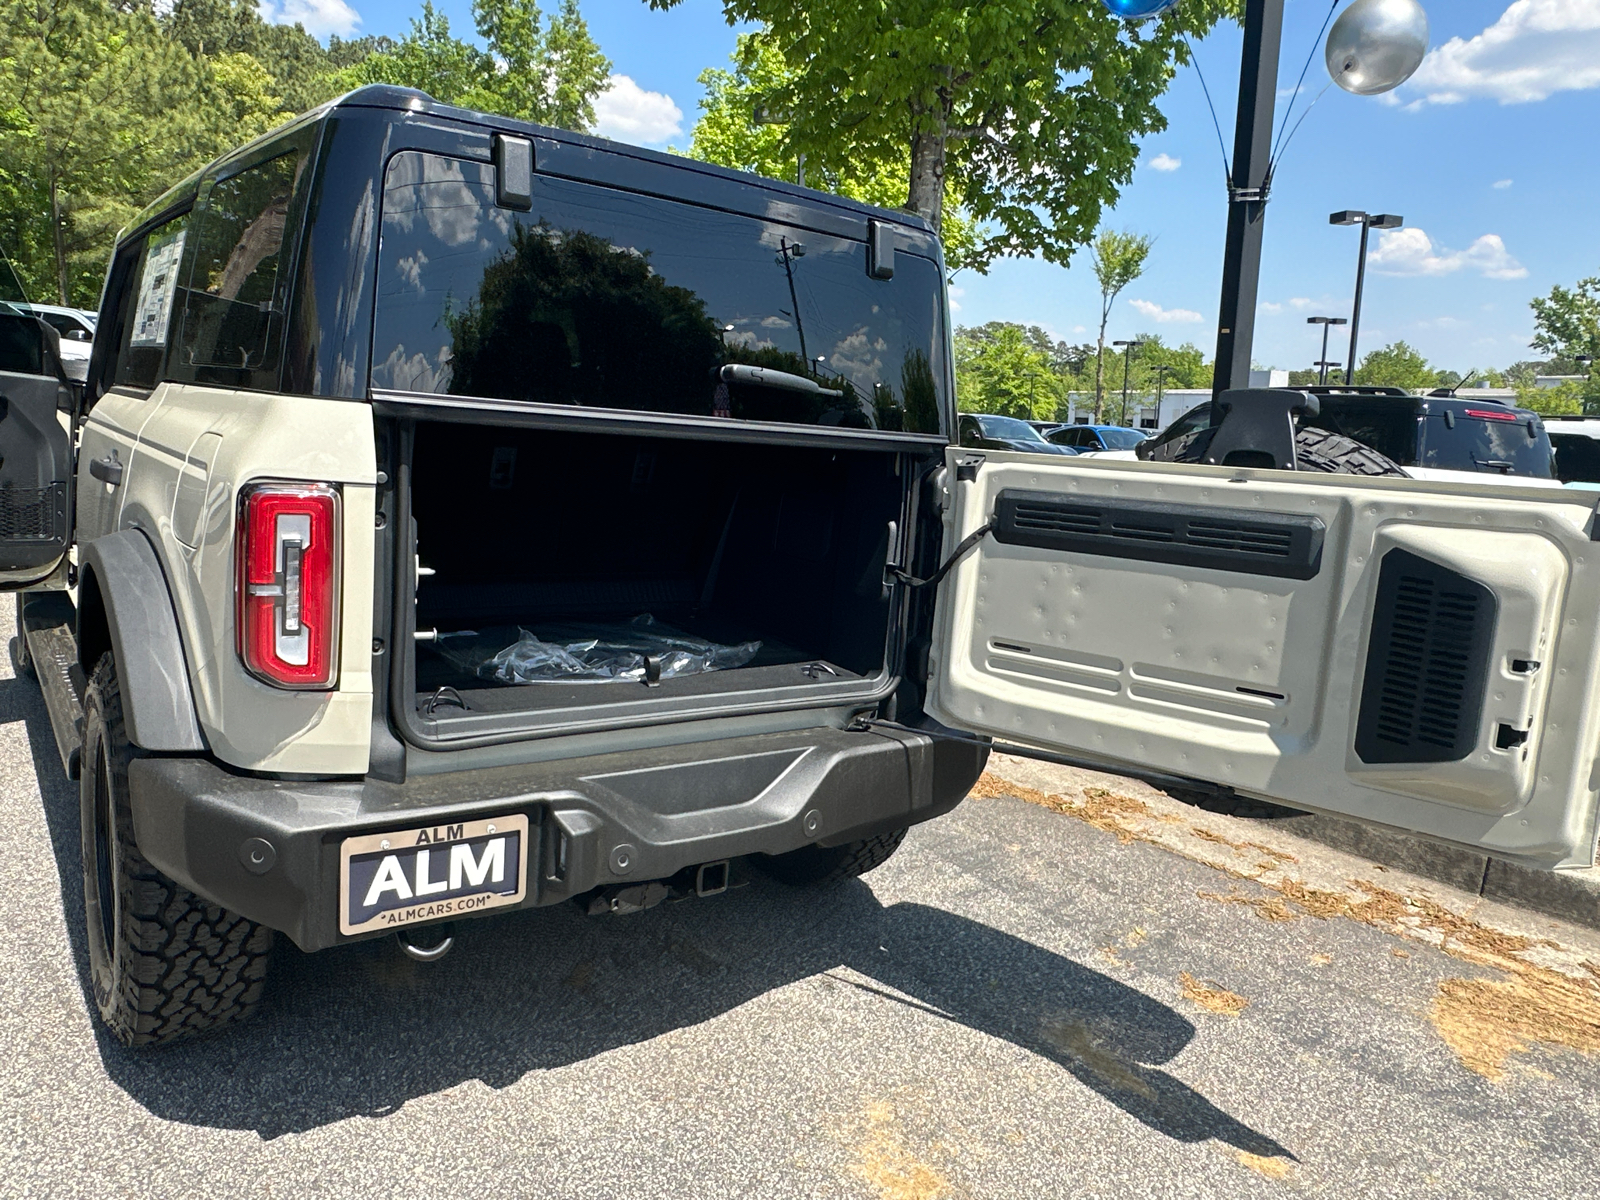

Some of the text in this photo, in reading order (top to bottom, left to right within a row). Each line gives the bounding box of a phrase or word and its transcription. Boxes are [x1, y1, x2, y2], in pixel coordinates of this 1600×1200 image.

[416, 824, 464, 845] ALM
[363, 838, 506, 906] ALM
[387, 896, 486, 924] ALMCARS.COM
